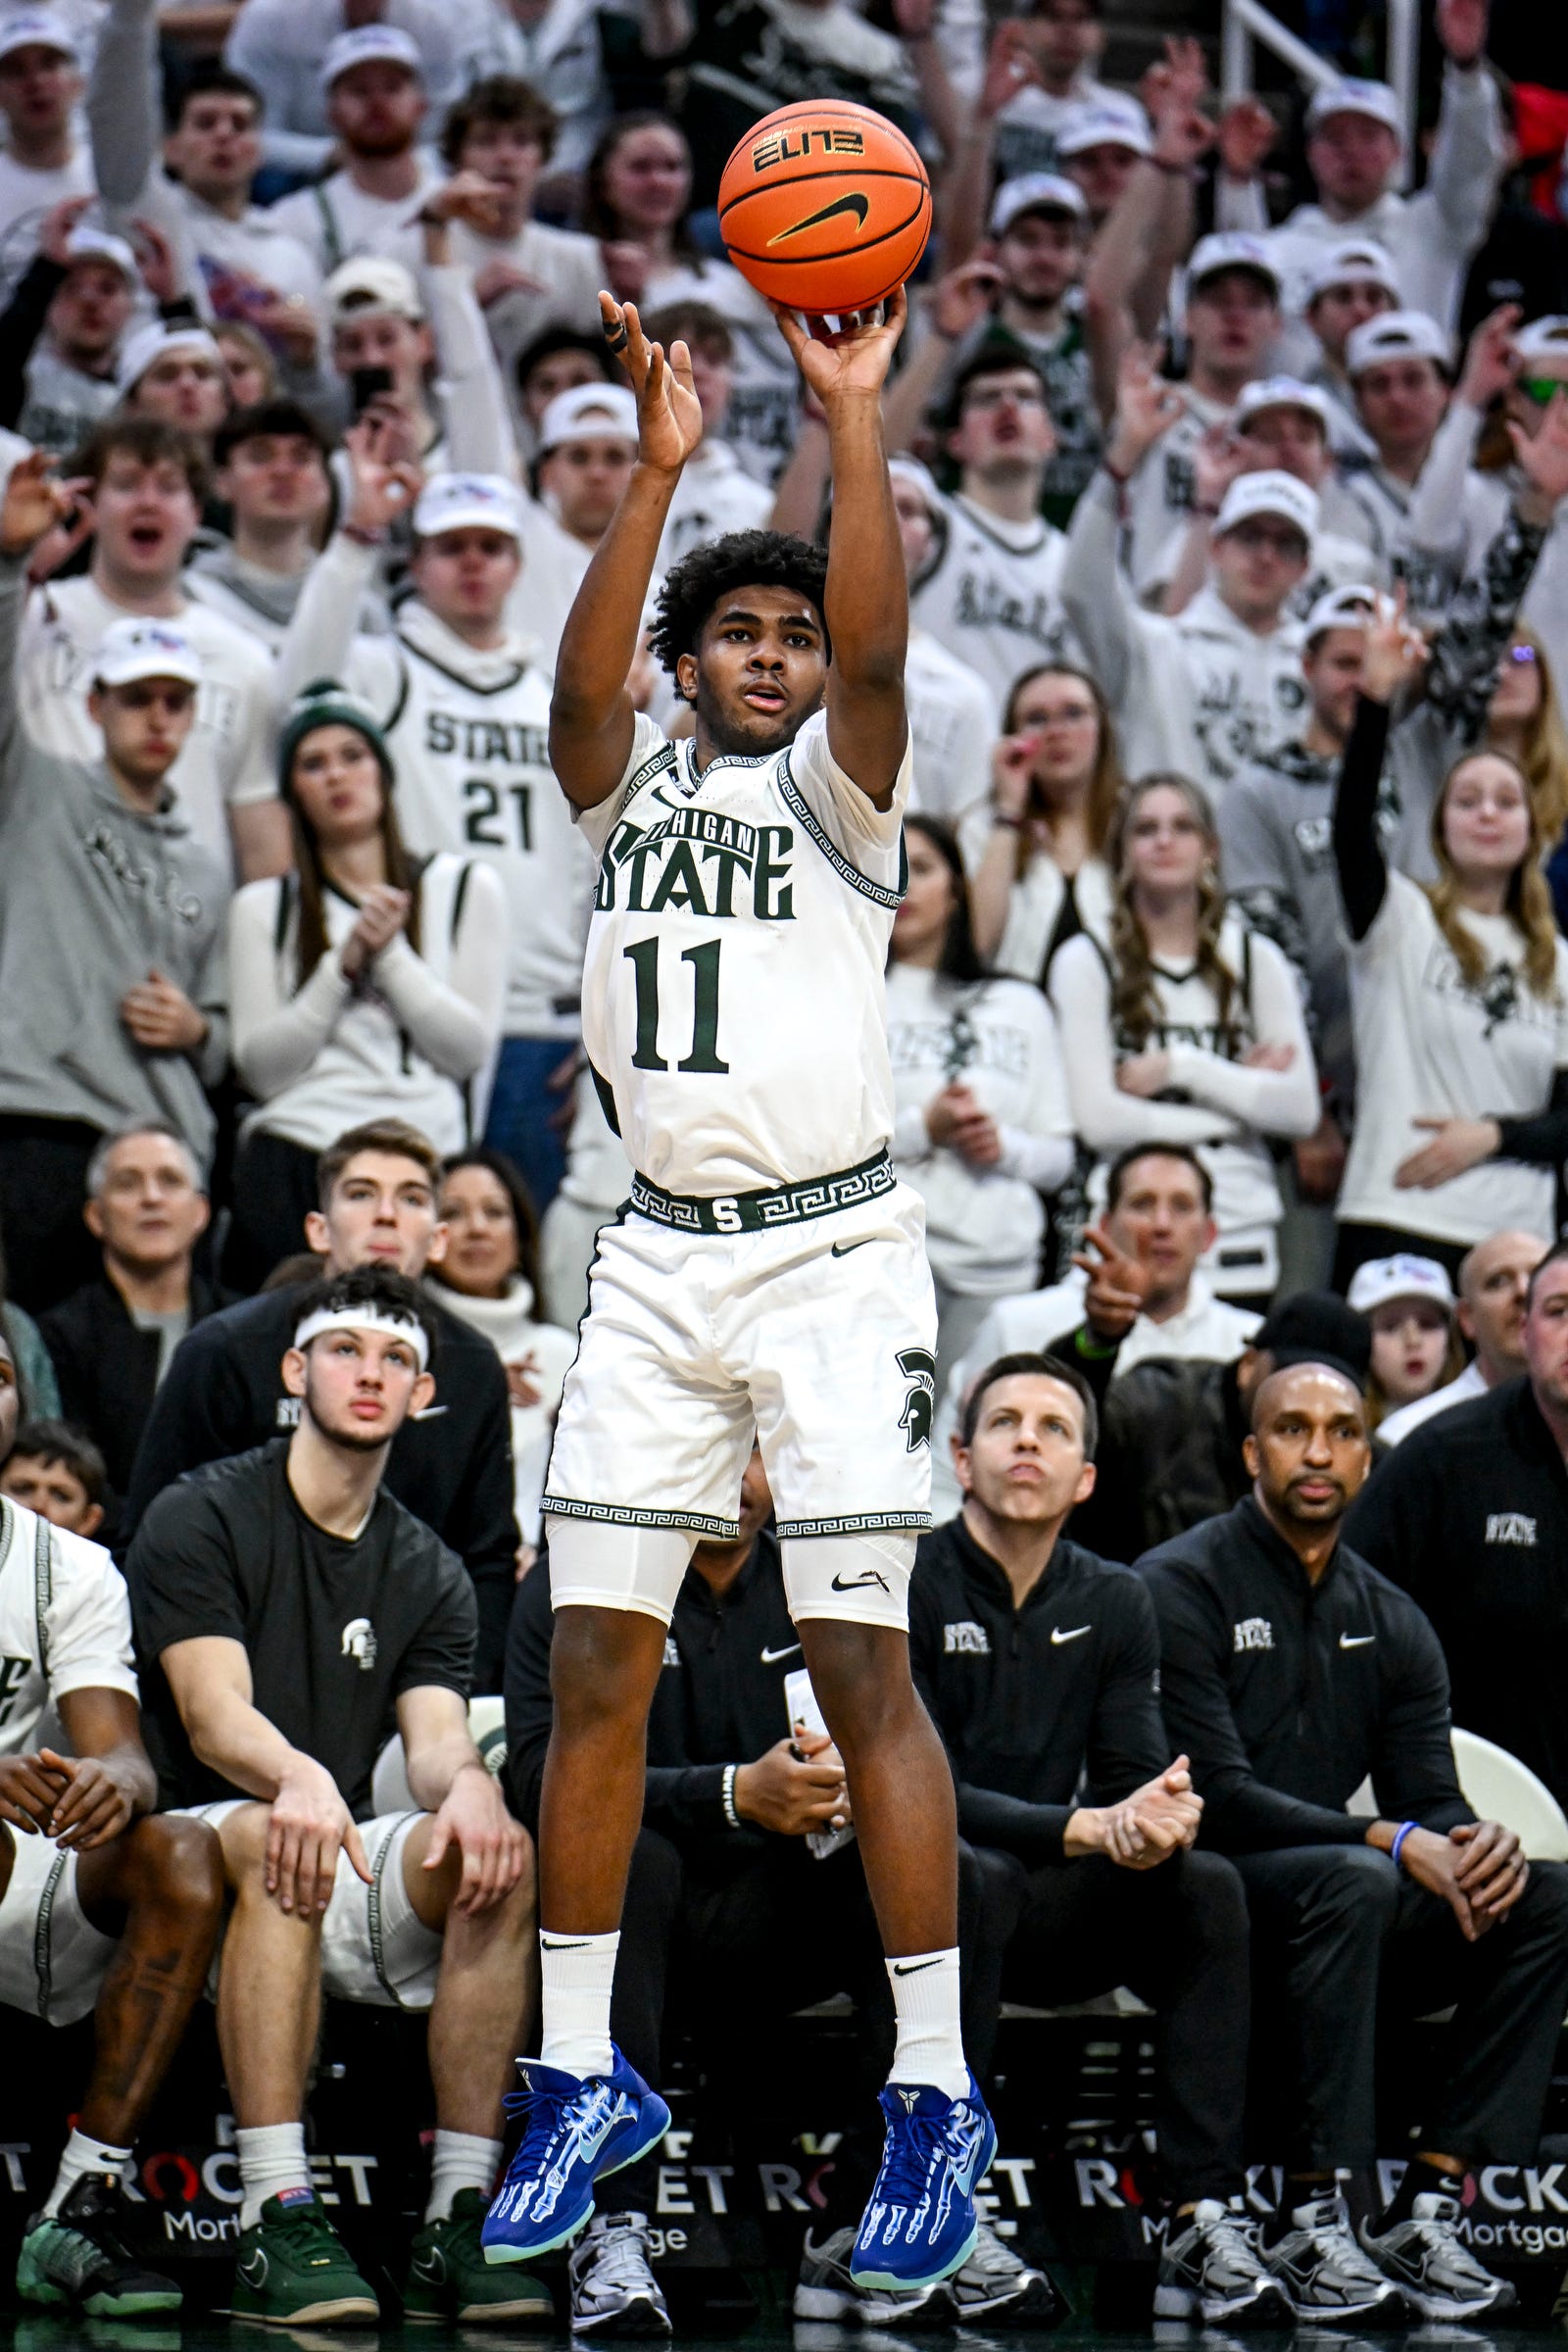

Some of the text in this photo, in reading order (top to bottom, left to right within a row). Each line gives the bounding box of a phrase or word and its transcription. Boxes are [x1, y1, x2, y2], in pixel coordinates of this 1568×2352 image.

[753, 129, 864, 172] ELITE
[463, 779, 532, 852] 21
[623, 936, 729, 1074] 11
[711, 1197, 743, 1232] S
[1456, 2217, 1568, 2254] Mortga
